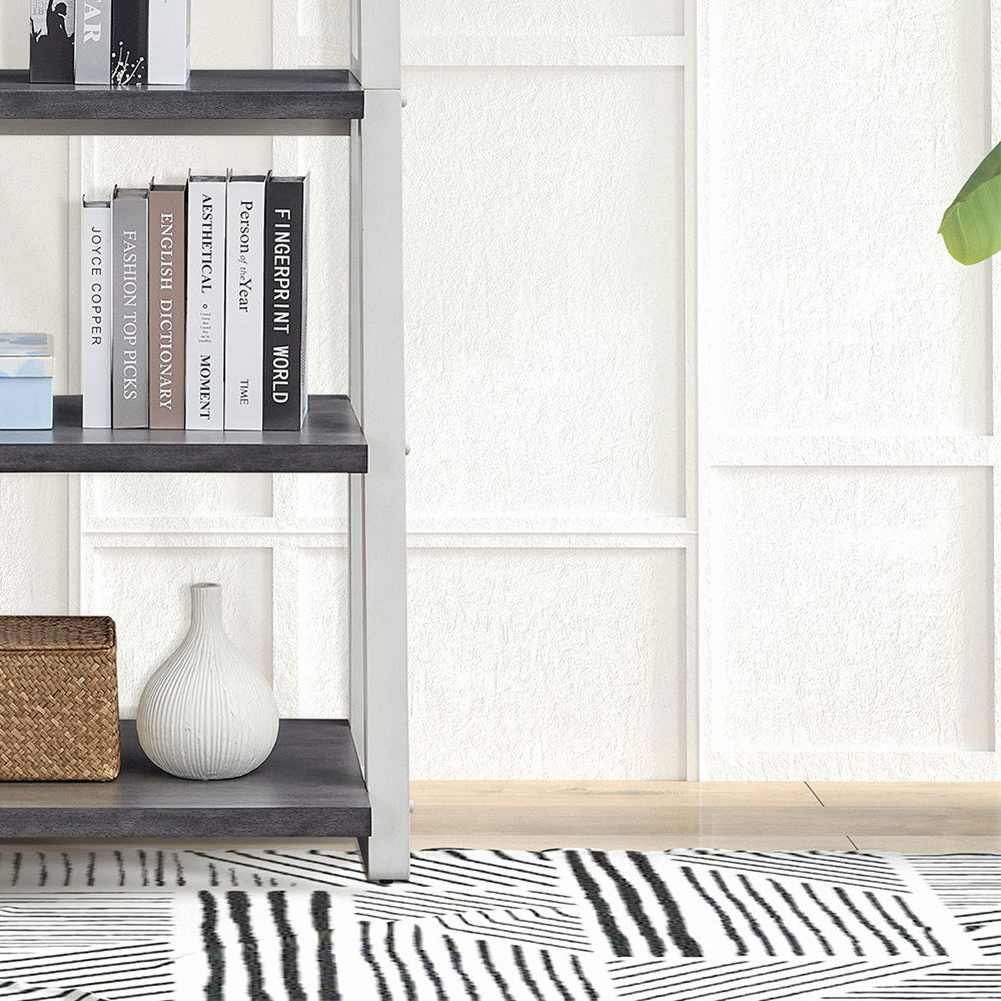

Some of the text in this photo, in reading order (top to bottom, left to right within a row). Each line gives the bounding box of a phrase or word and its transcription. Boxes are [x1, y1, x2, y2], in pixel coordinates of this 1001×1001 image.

[201, 193, 213, 294] AESTHETICAL
[237, 254, 249, 265] of
[239, 200, 253, 254] Person
[91, 226, 102, 346] JOYCE COPPER
[123, 230, 138, 400] FASHION TOP PICKS
[159, 213, 173, 410] ENGLISH DICTIONARY
[238, 278, 252, 313] Year
[272, 209, 291, 403] FINGERPRINT WORLD
[199, 354, 211, 421] MOMENT
[239, 378, 249, 405] TIME
